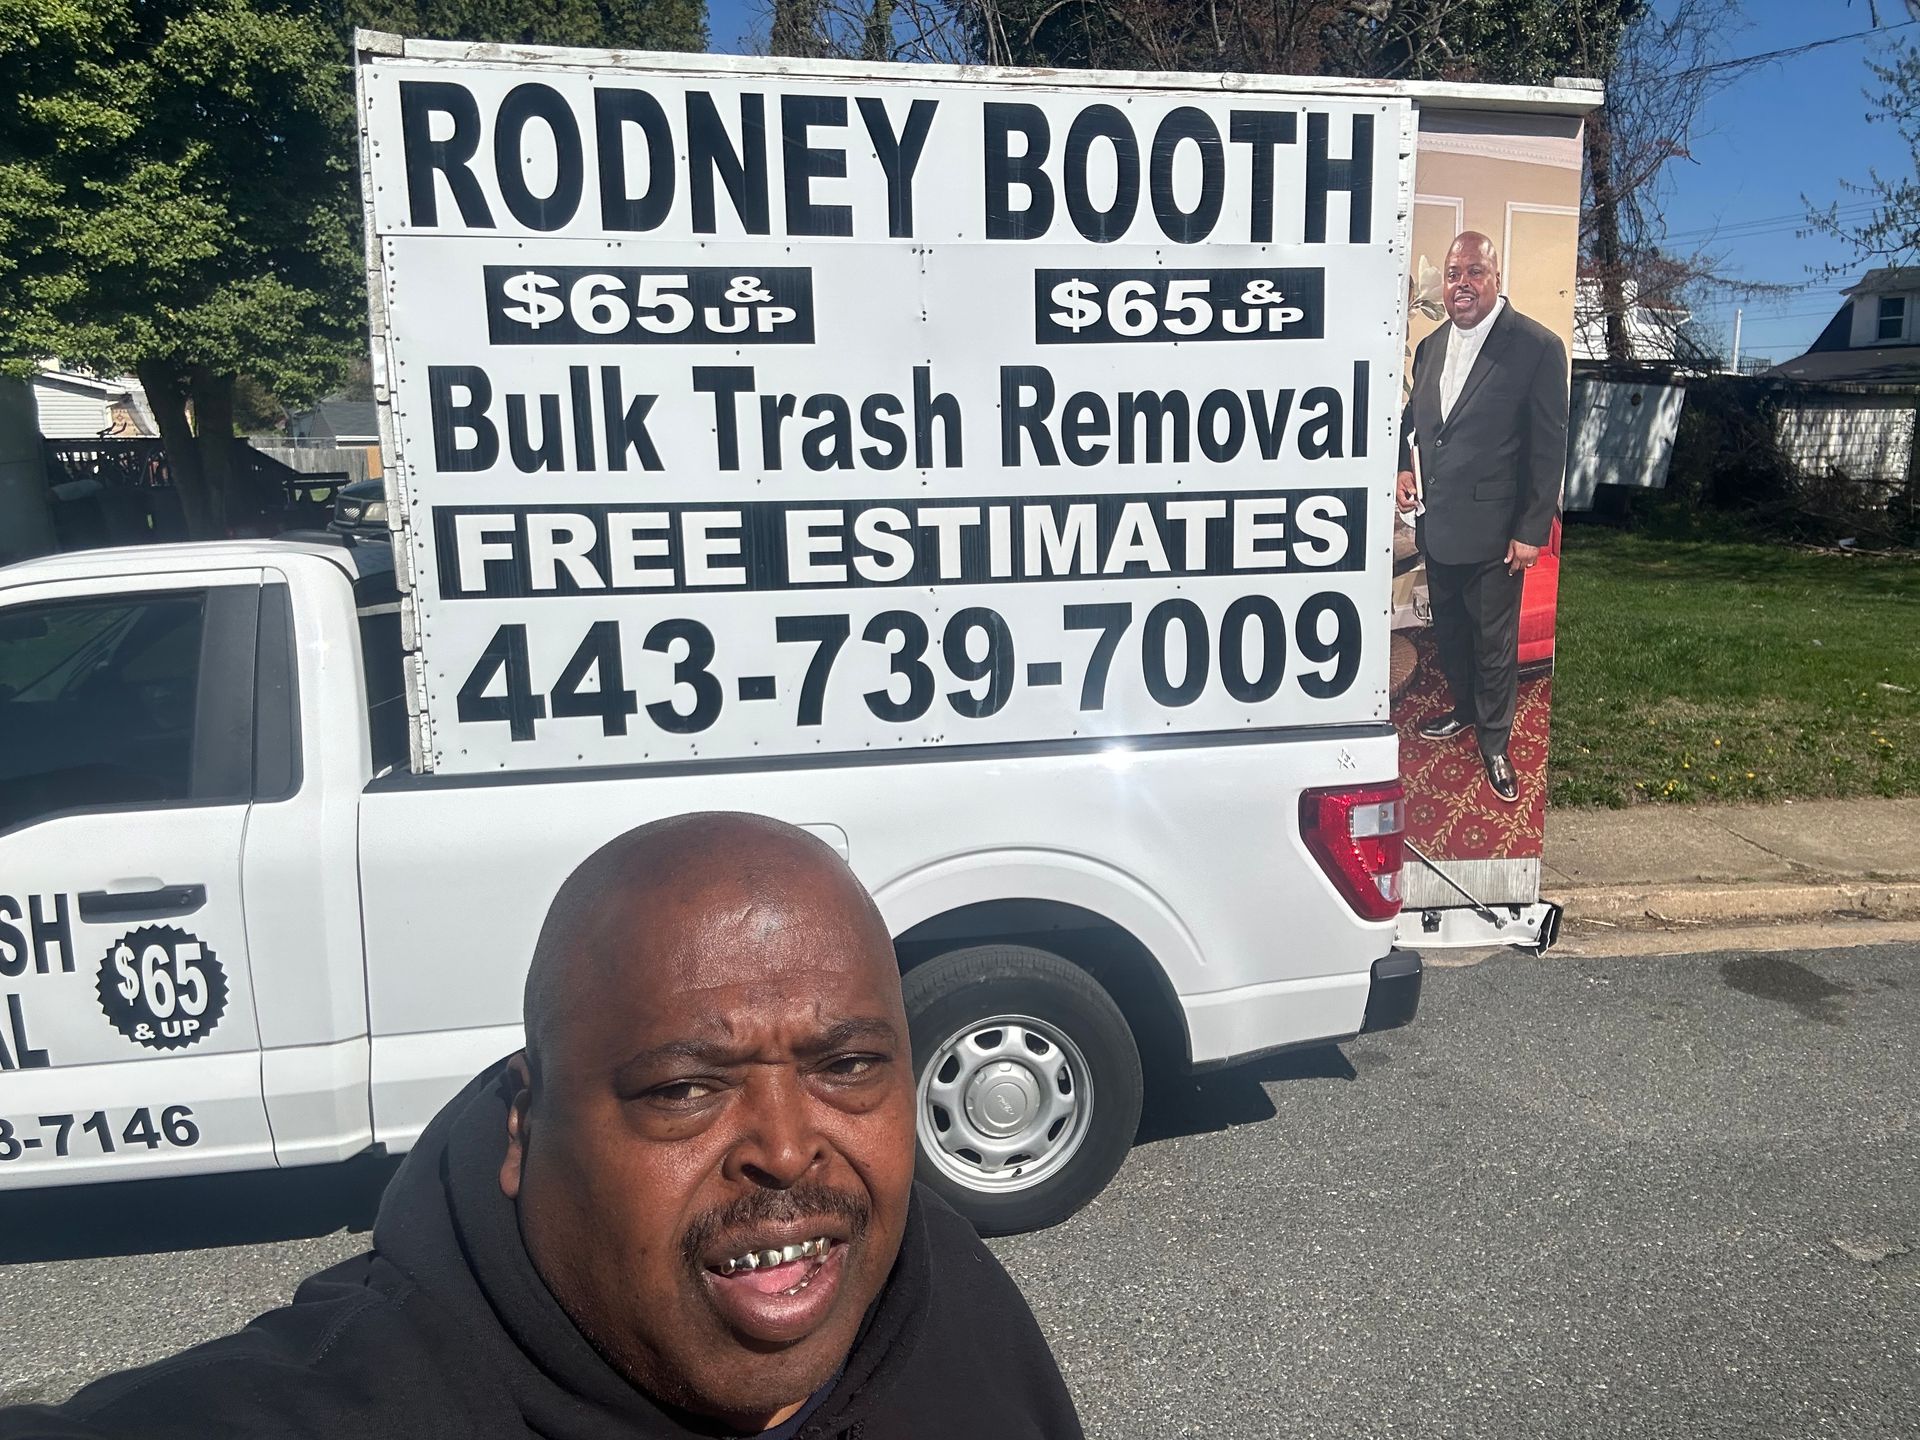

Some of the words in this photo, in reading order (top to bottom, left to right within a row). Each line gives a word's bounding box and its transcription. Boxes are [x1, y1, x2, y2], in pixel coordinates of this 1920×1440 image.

[399, 80, 939, 238] RODNEY
[984, 101, 1375, 244] BOOTH
[502, 271, 695, 335] $65
[724, 276, 775, 303] &
[704, 306, 797, 334] UP
[1049, 278, 1213, 336] $65
[1240, 279, 1286, 305] &
[1221, 307, 1305, 333] UP
[428, 365, 666, 474] Bulk
[692, 365, 963, 471] Trash
[1000, 360, 1370, 467] Removal
[454, 510, 747, 592] FREE
[785, 495, 1348, 583] ESTIMATES
[456, 591, 1362, 742] 443-739-7009
[114, 943, 208, 1018] $65
[0, 993, 50, 1070] L
[135, 1023, 155, 1040] &
[161, 1019, 200, 1037] UP
